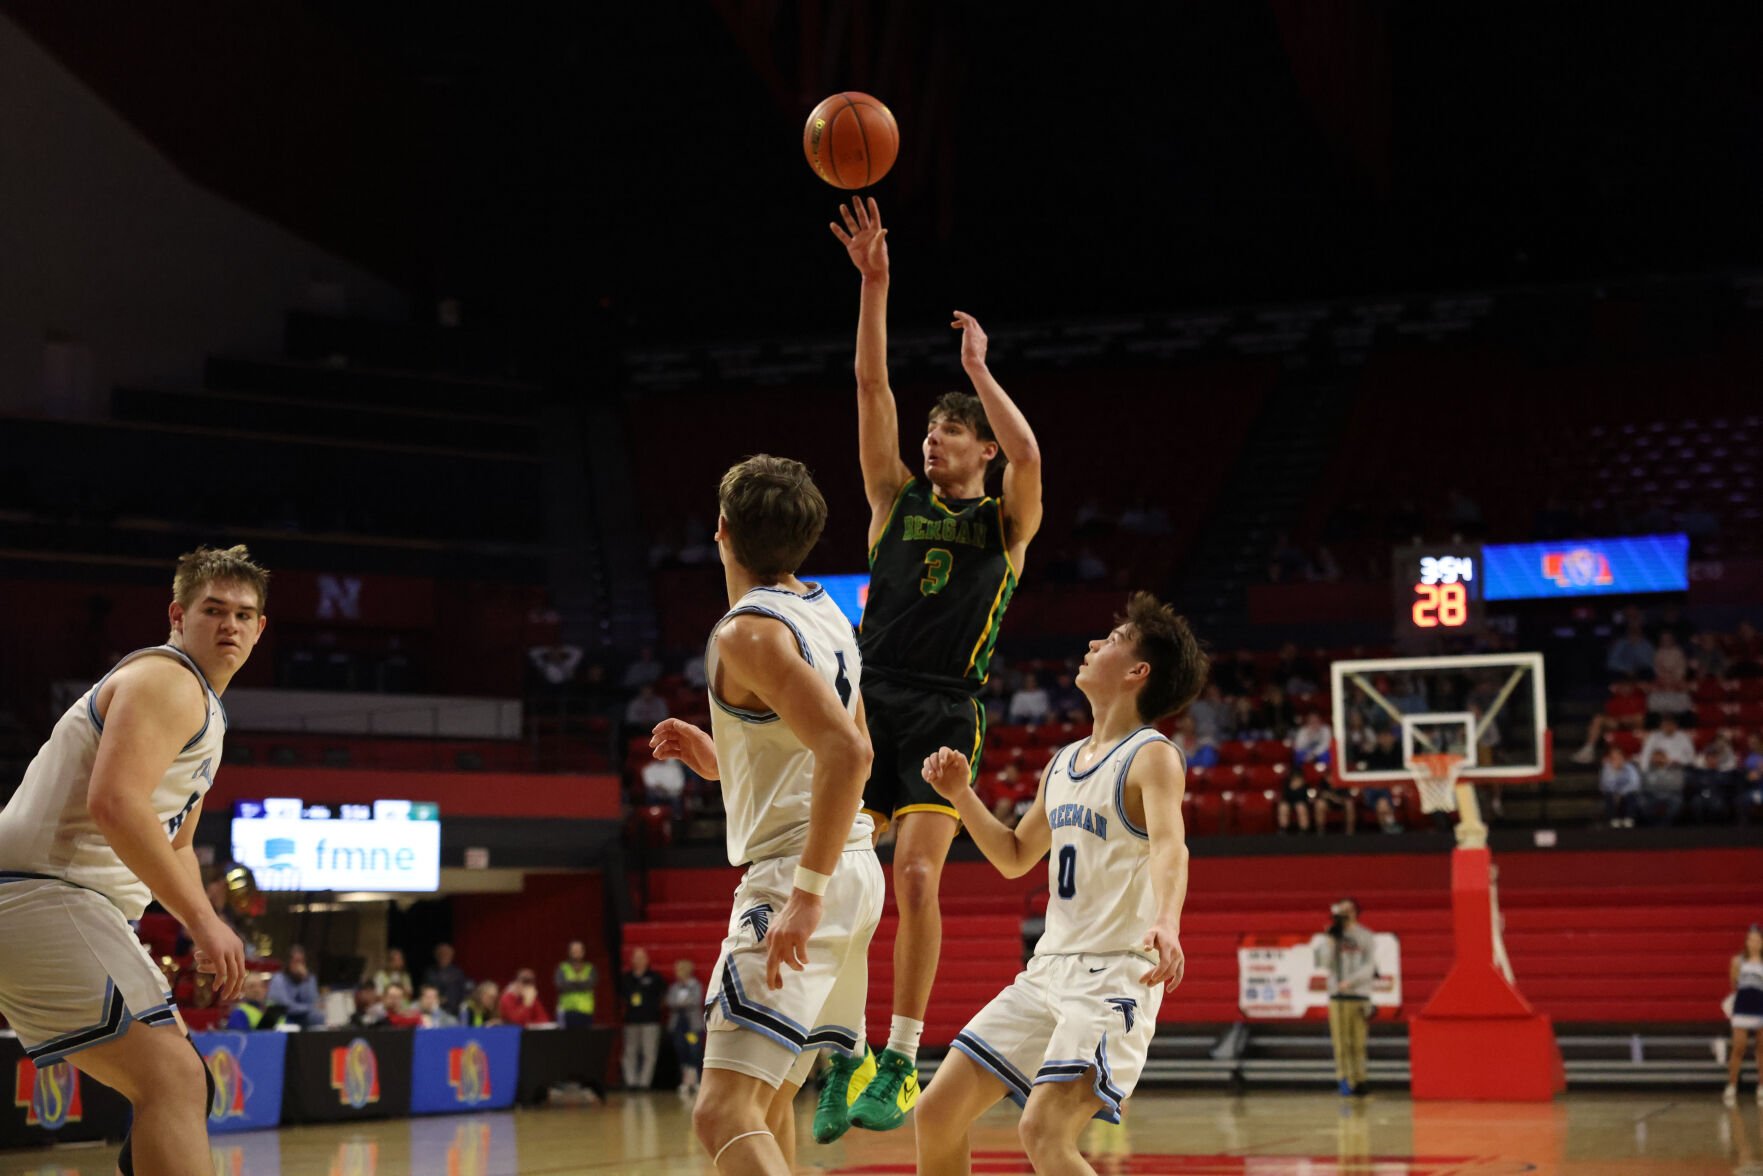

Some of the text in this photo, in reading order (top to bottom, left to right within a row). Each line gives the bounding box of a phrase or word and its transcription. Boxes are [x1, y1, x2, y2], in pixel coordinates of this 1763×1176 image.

[920, 547, 953, 597] 3
[317, 575, 361, 619] N
[1412, 582, 1467, 627] 28
[1049, 803, 1107, 841] REEMAN
[316, 838, 415, 870] fmne
[1058, 844, 1076, 899] 0
